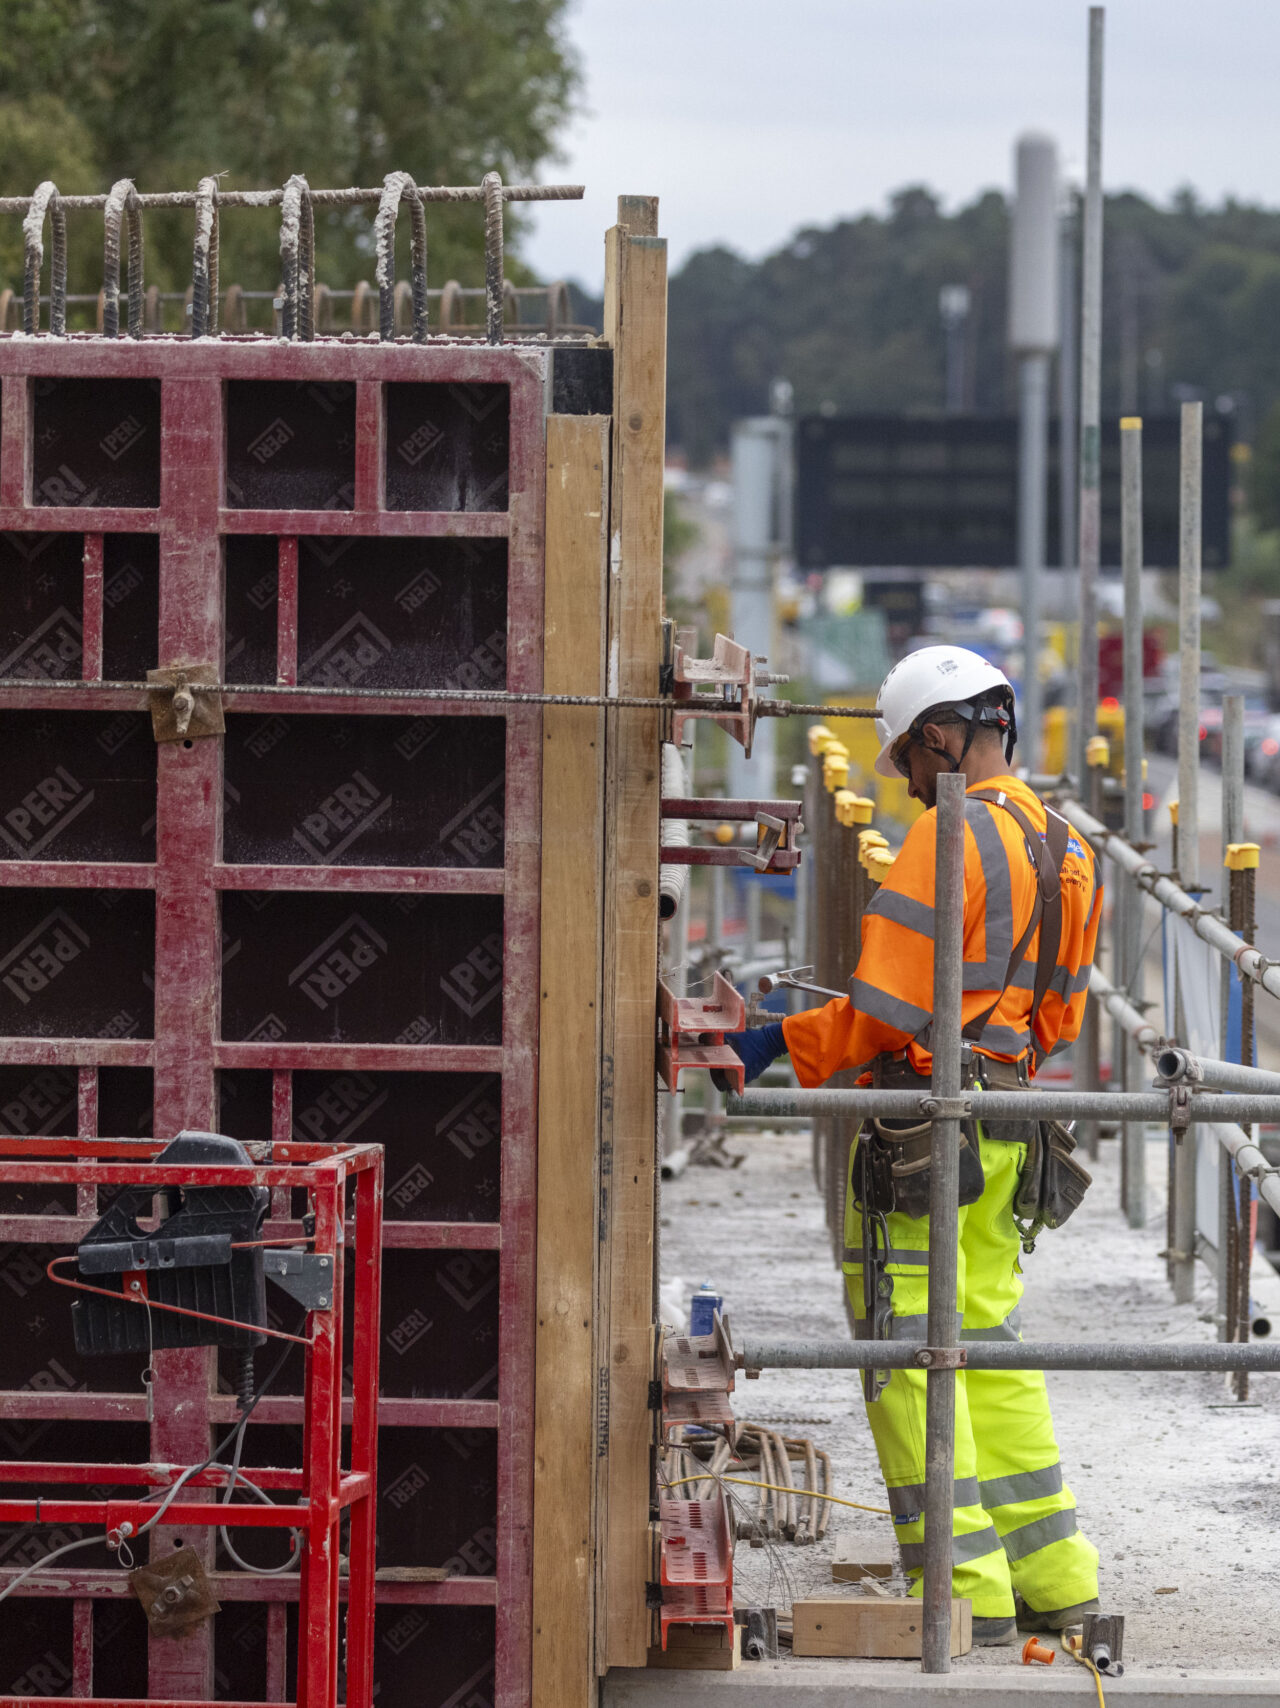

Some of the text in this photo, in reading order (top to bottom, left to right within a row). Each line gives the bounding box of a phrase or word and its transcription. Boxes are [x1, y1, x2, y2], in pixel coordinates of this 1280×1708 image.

[103, 414, 142, 450] PERI
[252, 427, 290, 464] PERI
[402, 420, 440, 456] PERI
[399, 577, 438, 614] PERI
[4, 765, 83, 841] PERI
[302, 769, 381, 848] PERI
[3, 927, 82, 1005] PERI
[299, 933, 379, 1011] PERI
[298, 1071, 377, 1141] PERI
[392, 1172, 430, 1208] PERI
[390, 1308, 428, 1345] PERI
[387, 1472, 425, 1509] PERI
[387, 1608, 424, 1645] PERI
